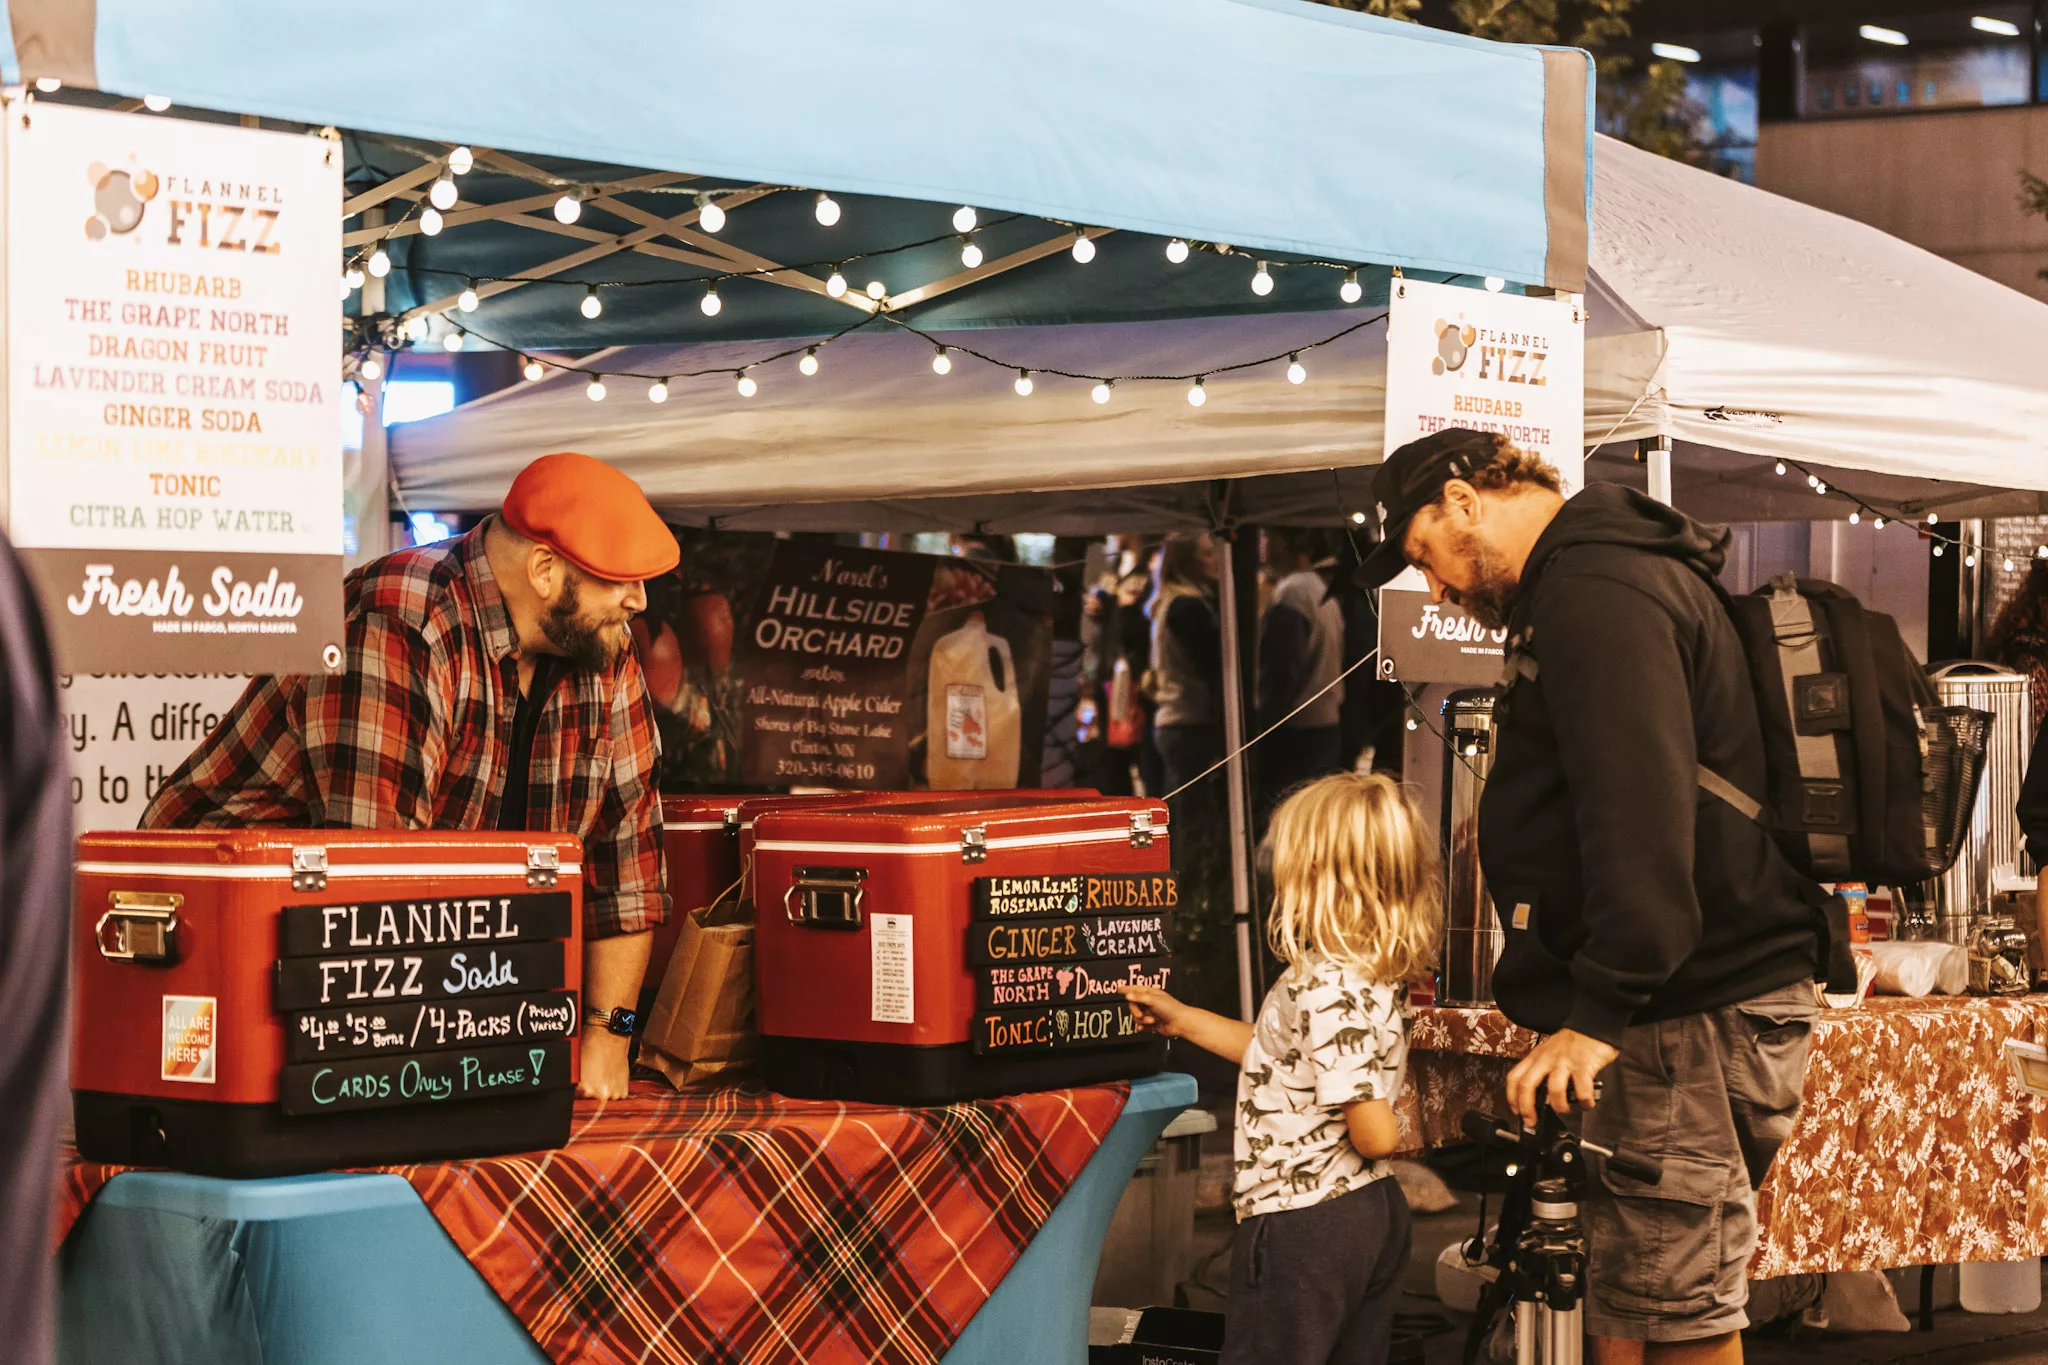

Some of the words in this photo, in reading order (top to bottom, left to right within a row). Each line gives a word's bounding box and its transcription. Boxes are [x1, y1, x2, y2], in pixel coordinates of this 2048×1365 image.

[167, 176, 284, 204] FLANNEL
[167, 200, 282, 255] FIZZ
[126, 268, 242, 299] RHUBARB
[64, 297, 112, 323] THE
[121, 303, 200, 330] GRAPE
[210, 310, 290, 336] NORTH
[88, 334, 189, 364] DRAGON
[199, 342, 268, 368] FRUIT
[1480, 329, 1549, 349] FLANNEL
[1479, 345, 1547, 387] FIZZ
[33, 365, 166, 395] LAVENDER
[175, 374, 257, 401] CREAM
[265, 380, 324, 404] SODA
[104, 404, 192, 430] GINGER
[202, 408, 263, 433] SODA
[1453, 394, 1523, 418] RHUBARB
[1418, 415, 1446, 432] THE
[1503, 424, 1550, 445] NORTH
[37, 434, 121, 460] LEMON
[132, 438, 189, 464] LIME
[196, 441, 322, 469] ROSEMARY
[149, 473, 221, 498] TONIC
[70, 504, 146, 529] CITRA
[157, 507, 203, 532] HOP
[213, 509, 295, 533] WATER
[67, 564, 194, 616] Fresh
[202, 566, 304, 617] Soda
[767, 585, 915, 628] HILLSIDE
[152, 621, 180, 633] MADE
[181, 621, 192, 633] IN
[228, 621, 259, 634] NORTH
[260, 622, 297, 634] DAKOTA
[1412, 605, 1487, 642] Fresh
[755, 618, 904, 660] ORCHARD
[1461, 647, 1477, 655] MADE
[746, 687, 820, 708] All-Natural
[822, 692, 861, 717] Apple
[864, 694, 902, 714] Cider
[112, 701, 135, 741] A
[151, 702, 228, 742] diffe
[792, 718, 807, 737] of
[863, 723, 893, 738] Lake
[99, 766, 129, 804] to
[990, 877, 1042, 897] LEMON
[1042, 876, 1079, 895] LIME
[1085, 878, 1179, 910] RHUBARB
[990, 895, 1065, 915] ROSEMARY
[321, 899, 519, 949] FLANNEL
[1097, 917, 1162, 936] LAVENDER
[987, 925, 1078, 960] GINGER
[1096, 934, 1157, 956] CREAM
[318, 956, 424, 1003] FIZZ
[443, 951, 519, 994] Soda
[991, 968, 1015, 985] THE
[1018, 966, 1054, 983] GRAPE
[1127, 963, 1171, 990] FRUIT
[992, 983, 1050, 1005] NORTH
[168, 1015, 187, 1030] ALL
[189, 1016, 211, 1031] ARE
[985, 1016, 1048, 1048] TONIC
[1073, 1009, 1113, 1040] HOP
[167, 1047, 198, 1063] HERE
[311, 1068, 392, 1105] CARDS
